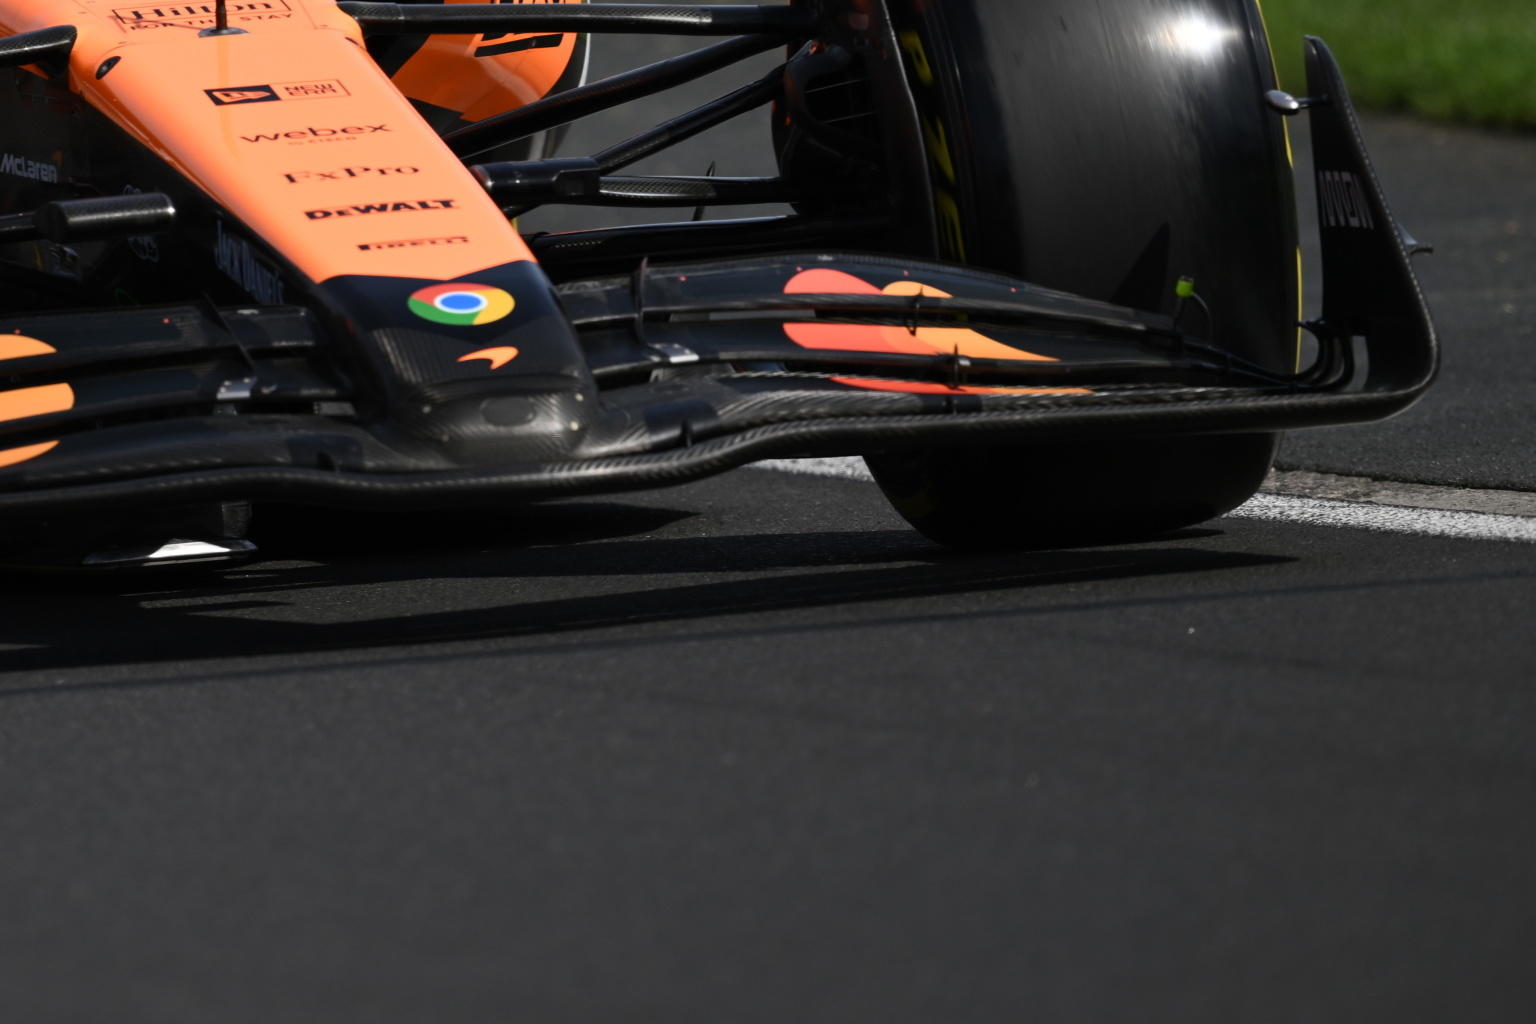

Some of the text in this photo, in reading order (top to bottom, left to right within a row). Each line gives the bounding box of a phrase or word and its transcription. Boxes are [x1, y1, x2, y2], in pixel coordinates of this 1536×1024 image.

[129, 0, 275, 21] Hilton
[240, 13, 292, 22] STAY
[240, 123, 393, 143] webex
[0, 153, 58, 184] McLaren
[283, 165, 420, 184] FxPro
[922, 112, 969, 264] ZE
[357, 236, 470, 252] PIRELLI
